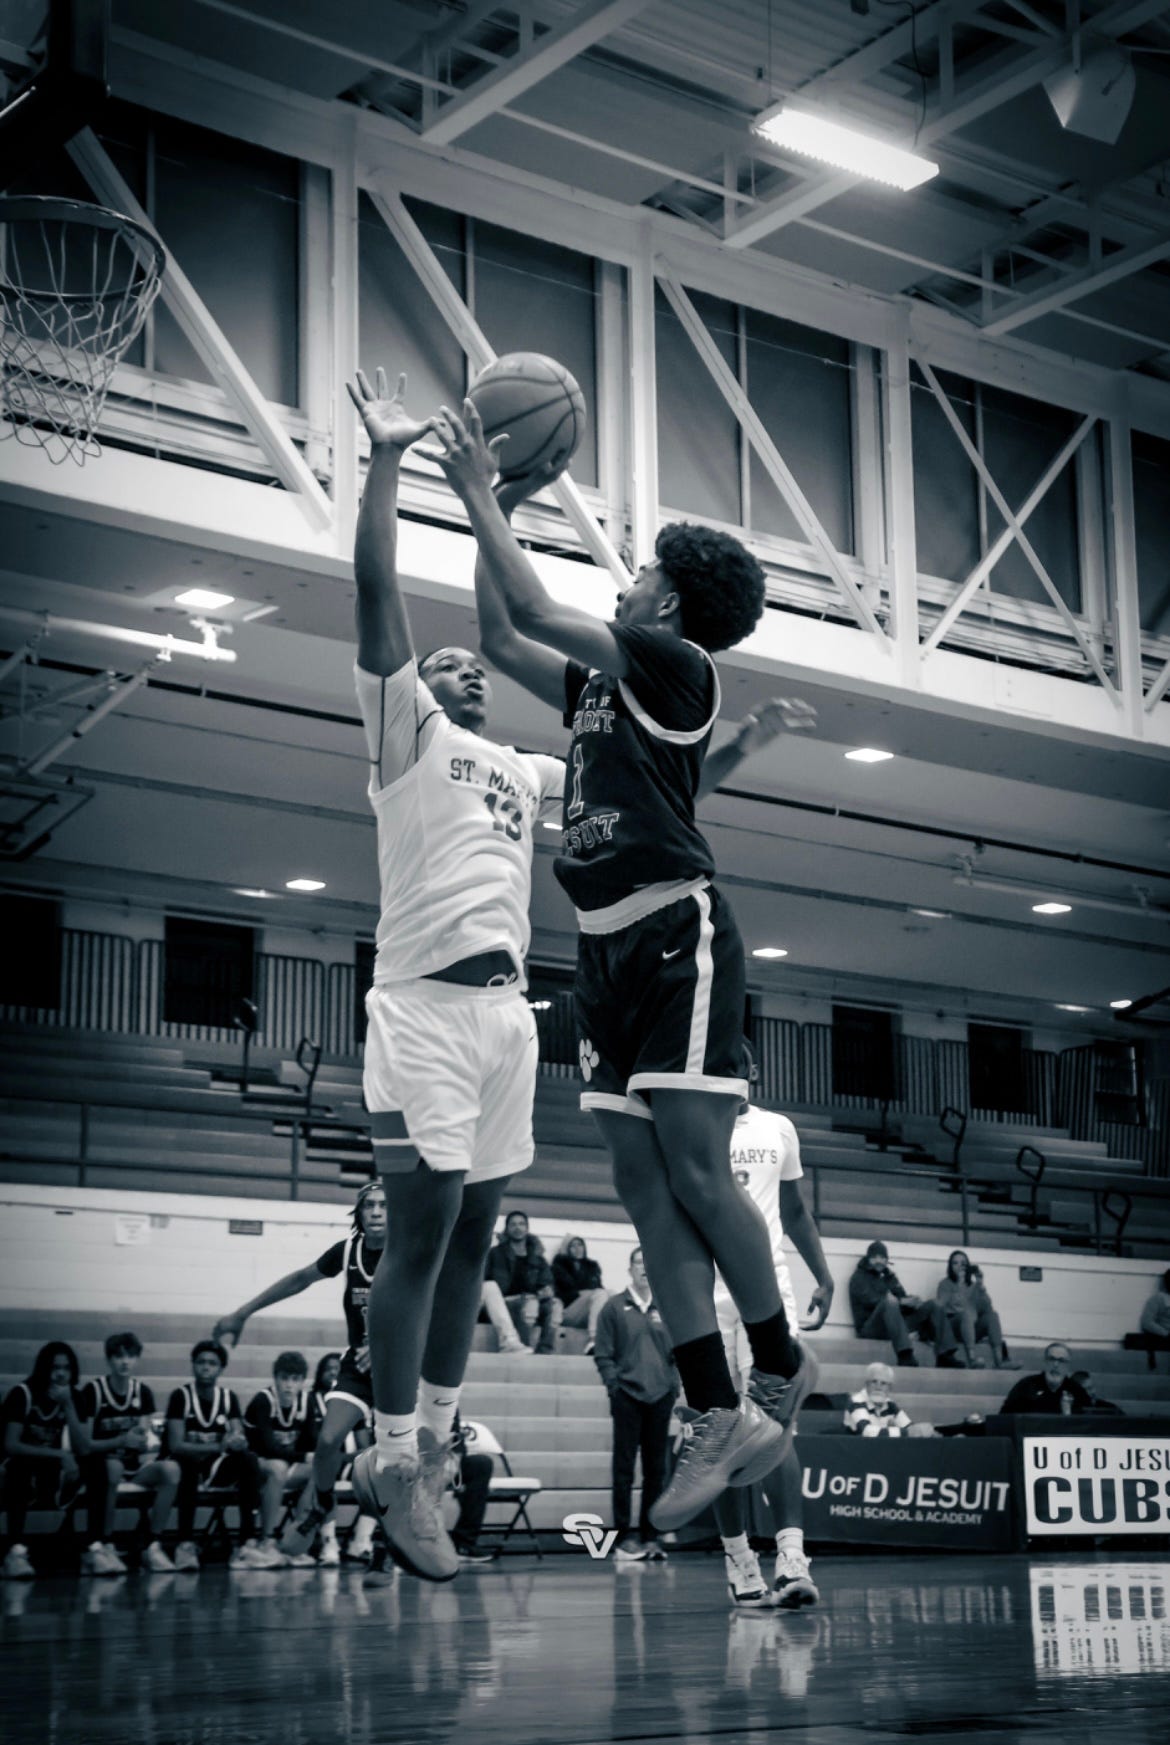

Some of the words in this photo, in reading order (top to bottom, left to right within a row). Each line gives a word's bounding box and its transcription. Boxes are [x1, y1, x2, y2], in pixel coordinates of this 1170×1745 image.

[450, 757, 480, 783] ST.
[567, 744, 584, 820] 1
[484, 792, 522, 842] 13
[1033, 1446, 1048, 1469] U
[1060, 1447, 1082, 1470] of
[1093, 1447, 1107, 1470] D
[801, 1467, 828, 1499] U
[829, 1475, 860, 1495] OF
[863, 1473, 889, 1503] D
[896, 1476, 1010, 1512] JESUIT
[1033, 1476, 1170, 1524] CUB
[830, 1504, 861, 1518] HIGH
[864, 1506, 912, 1522] SCHOOL
[915, 1510, 924, 1522] &
[926, 1511, 983, 1525] ACADEMY
